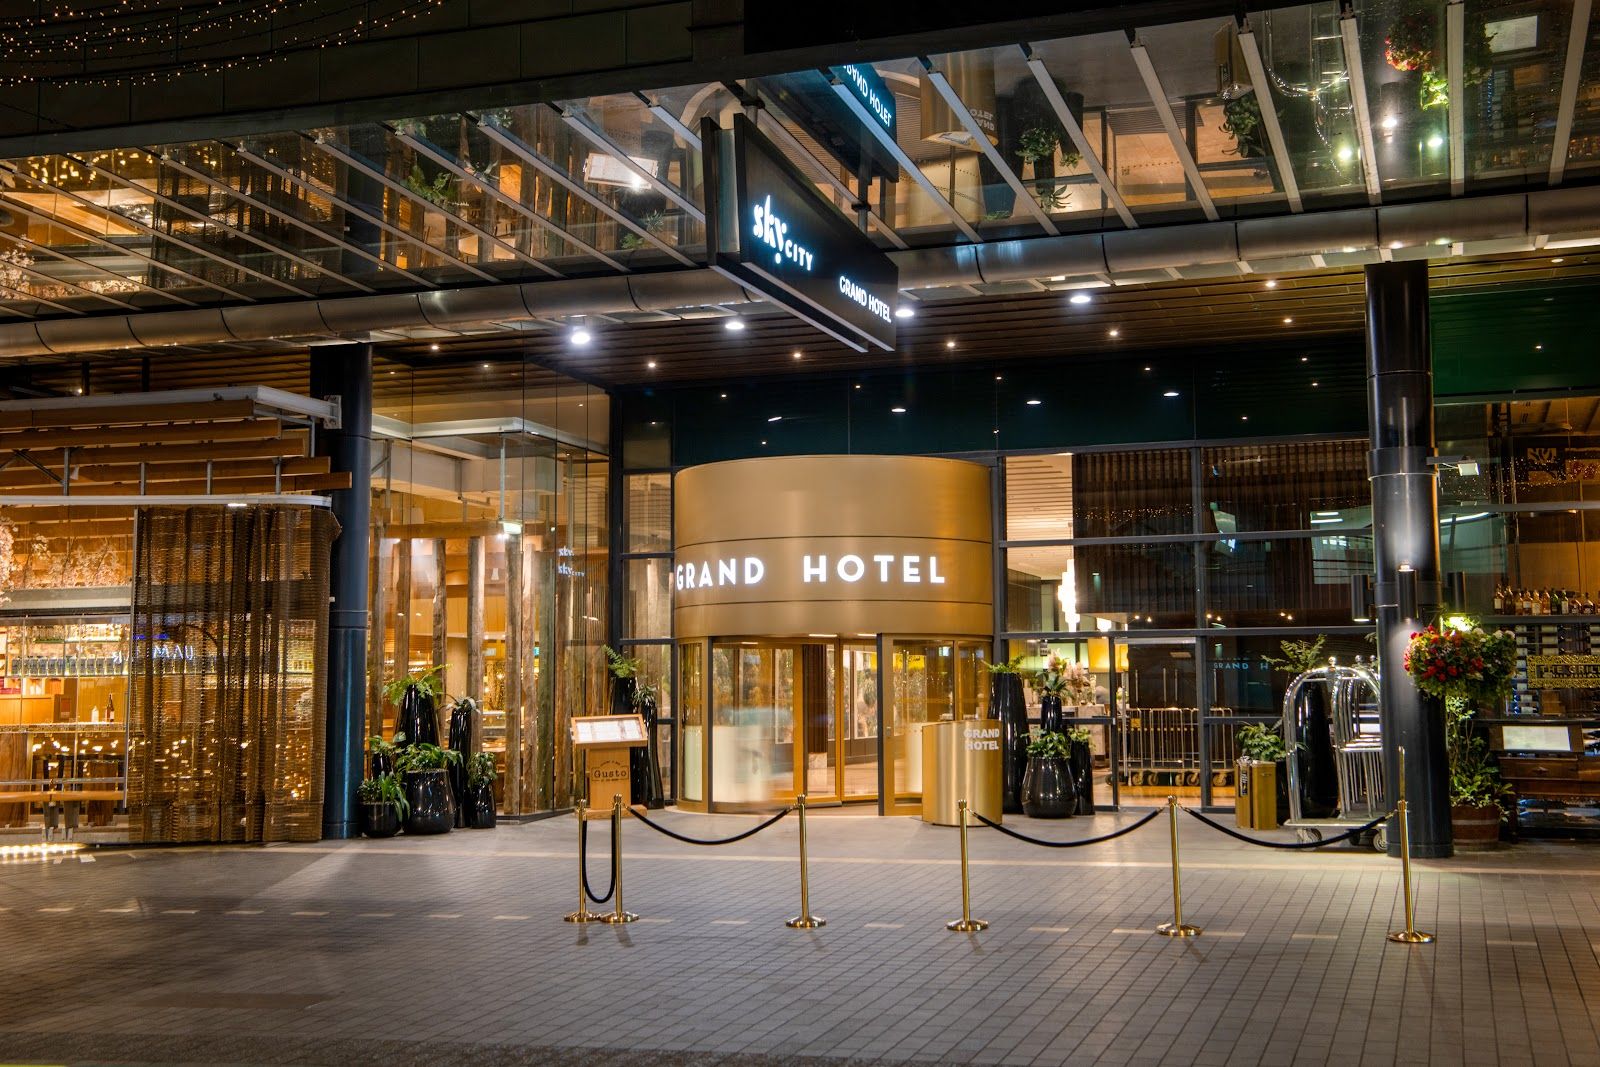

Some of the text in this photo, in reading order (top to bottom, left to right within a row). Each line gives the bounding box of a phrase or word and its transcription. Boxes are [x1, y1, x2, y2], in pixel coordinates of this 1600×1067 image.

[839, 275, 892, 323] GRAND HOTEL
[676, 554, 946, 590] GRAND HOTEL
[1213, 662, 1249, 670] GRAND
[963, 728, 1000, 738] GRAND
[965, 741, 1000, 750] HOTEL
[593, 769, 627, 778] Gusto
